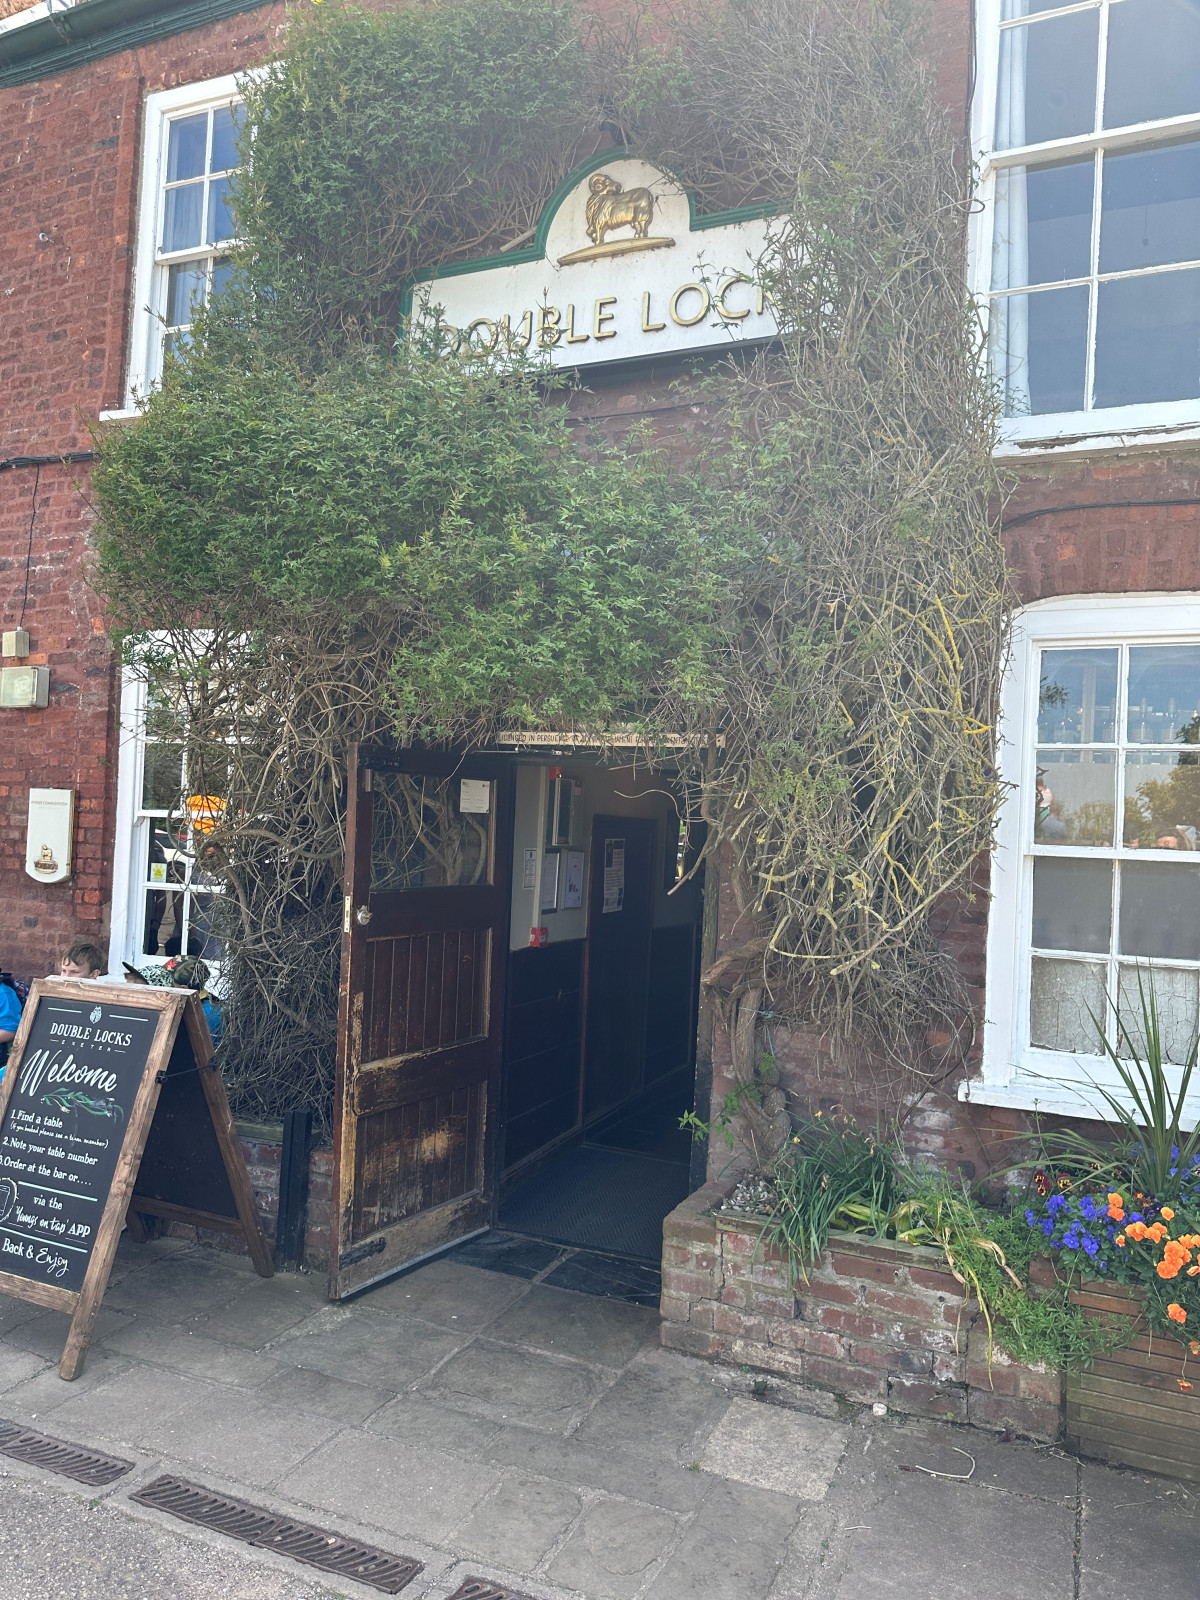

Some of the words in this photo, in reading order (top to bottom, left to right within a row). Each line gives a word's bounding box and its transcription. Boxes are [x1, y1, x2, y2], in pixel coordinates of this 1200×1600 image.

[641, 275, 786, 334] LOCK
[50, 1022, 92, 1040] DOUBLE
[94, 1029, 132, 1046] LOCKS
[61, 1039, 111, 1052] EXETER
[20, 1049, 117, 1096] Welcome
[36, 1116, 42, 1124] a
[44, 1115, 63, 1128] table
[27, 1143, 46, 1153] your
[47, 1146, 66, 1159] table
[67, 1152, 98, 1165] number
[27, 1163, 36, 1173] at
[38, 1164, 51, 1177] the
[52, 1167, 68, 1179] bar
[33, 1194, 46, 1207] via
[48, 1197, 63, 1210] the
[39, 1219, 49, 1229] on
[68, 1222, 91, 1238] APP
[2, 1237, 25, 1256] Back
[26, 1244, 34, 1259] &
[35, 1247, 70, 1278] Enjoy
